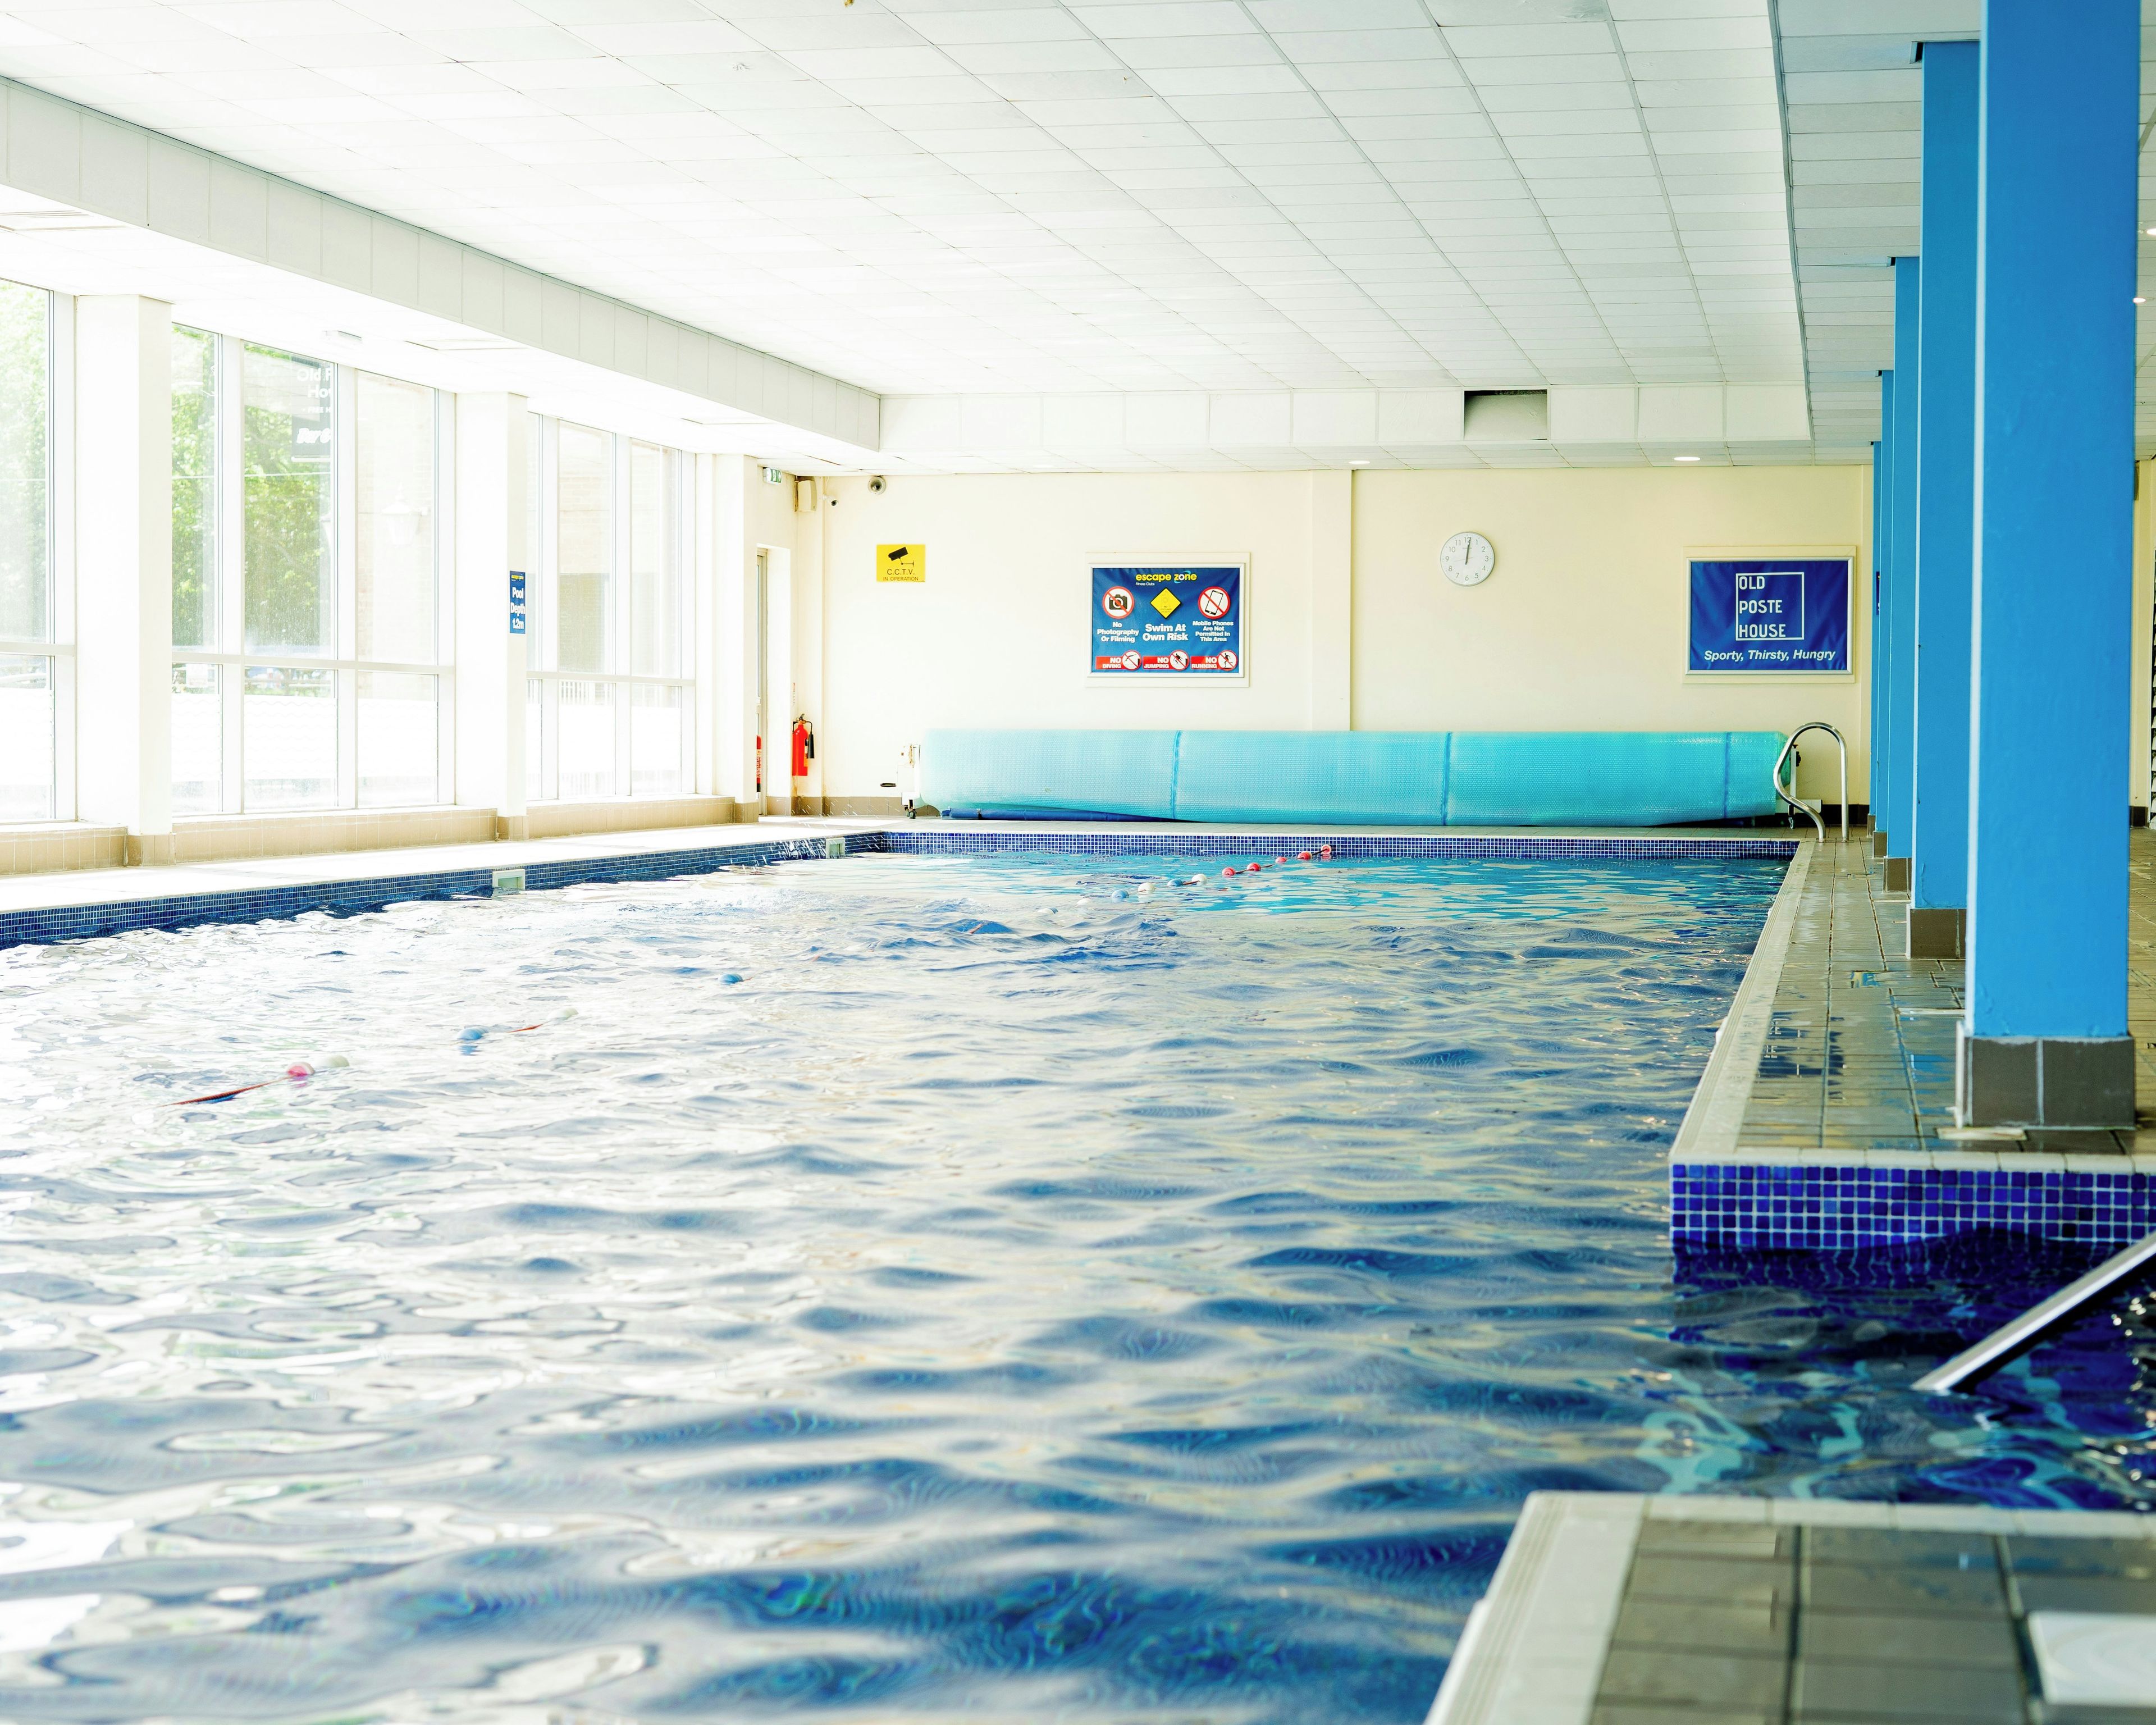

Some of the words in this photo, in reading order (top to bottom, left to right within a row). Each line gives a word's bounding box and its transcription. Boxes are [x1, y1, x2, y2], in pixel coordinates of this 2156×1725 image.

[296, 368, 321, 381] Old
[1135, 574, 1172, 582] escape
[1739, 576, 1765, 590] OLD
[512, 587, 524, 599] Pool
[510, 602, 526, 617] Depth
[1739, 600, 1782, 614] POSTE
[1145, 623, 1173, 632] Swim
[1175, 623, 1186, 632] At
[1739, 624, 1785, 638] HOUSE
[1143, 632, 1165, 641] Own
[1167, 632, 1189, 641] Risk
[1704, 650, 1744, 662] Sporty,
[1748, 650, 1789, 661] Thirsty,
[1793, 649, 1836, 661] Hungry
